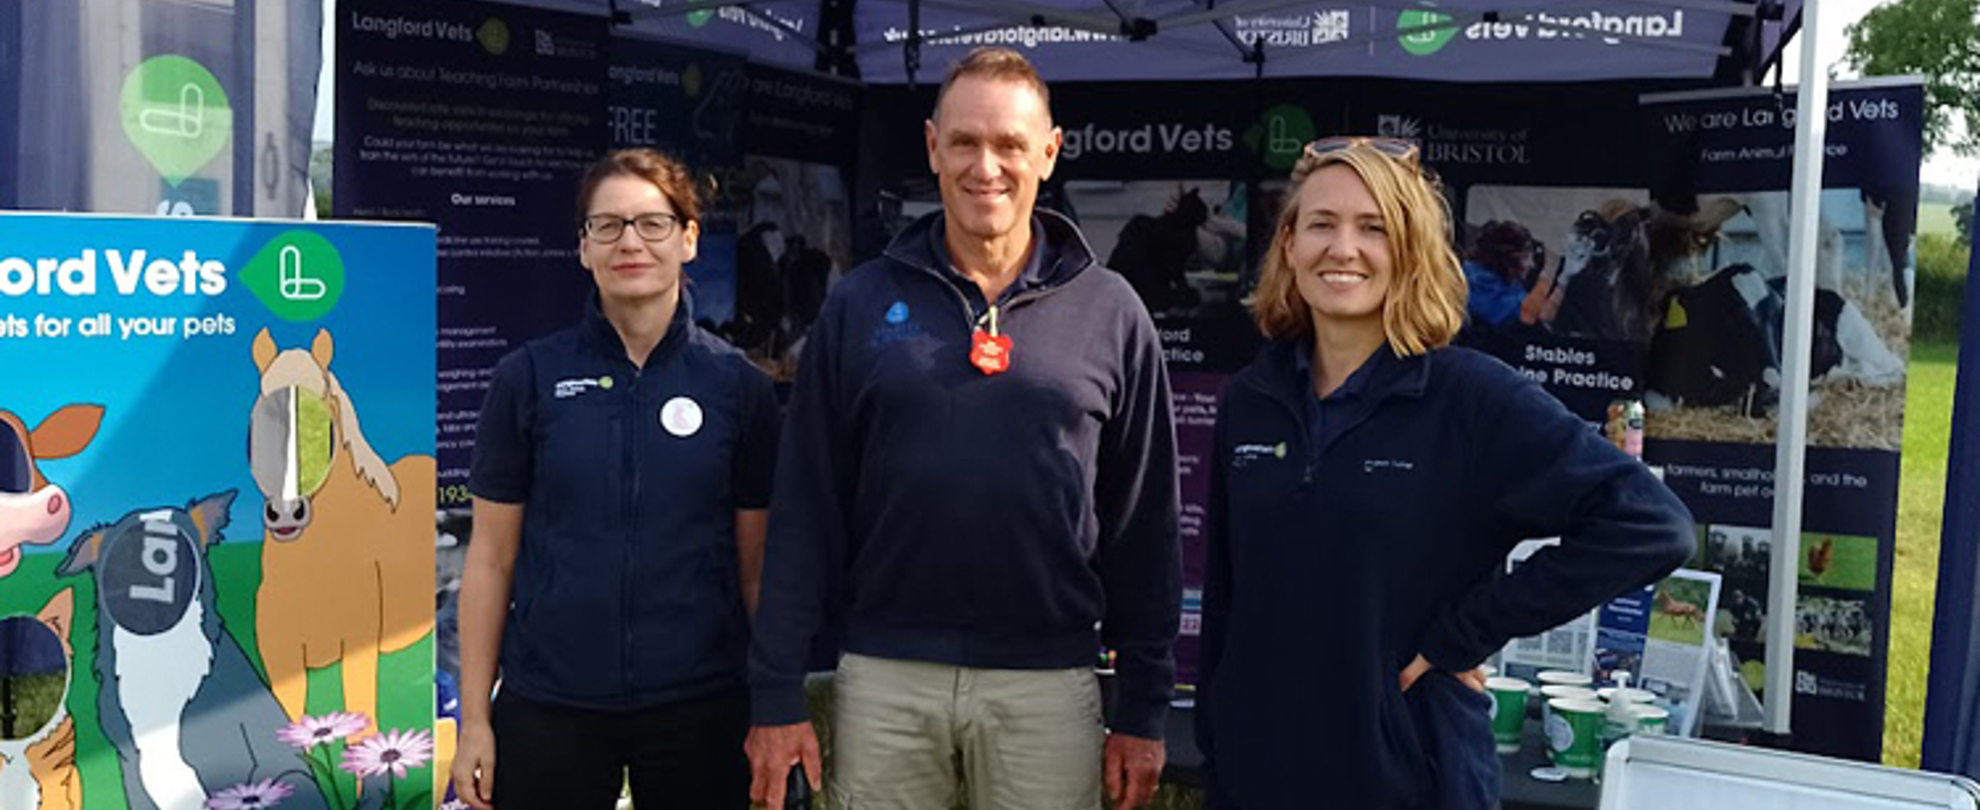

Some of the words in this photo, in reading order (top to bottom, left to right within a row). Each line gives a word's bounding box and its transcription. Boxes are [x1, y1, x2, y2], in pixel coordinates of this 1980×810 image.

[353, 12, 433, 39] Langford
[435, 21, 473, 42] Vets
[353, 61, 376, 76] Ask
[379, 66, 394, 77] us
[396, 66, 436, 81] about
[1664, 114, 1696, 132] We
[1701, 111, 1736, 128] are
[1850, 100, 1898, 120] Vets
[1157, 122, 1235, 152] Vets
[1427, 141, 1531, 164] BRISTOL
[1702, 148, 1735, 162] Farm
[451, 193, 472, 206] Our
[474, 194, 516, 206] services
[0, 249, 96, 297] ord
[105, 249, 227, 297] Vets
[35, 313, 72, 338] for
[78, 313, 111, 336] all
[118, 317, 177, 340] your
[183, 313, 236, 339] pets
[1525, 345, 1596, 365] Stables
[1554, 369, 1634, 390] Practice
[1701, 482, 1732, 495] farm
[1734, 483, 1759, 498] pet
[1810, 471, 1839, 486] and
[1842, 472, 1868, 488] the
